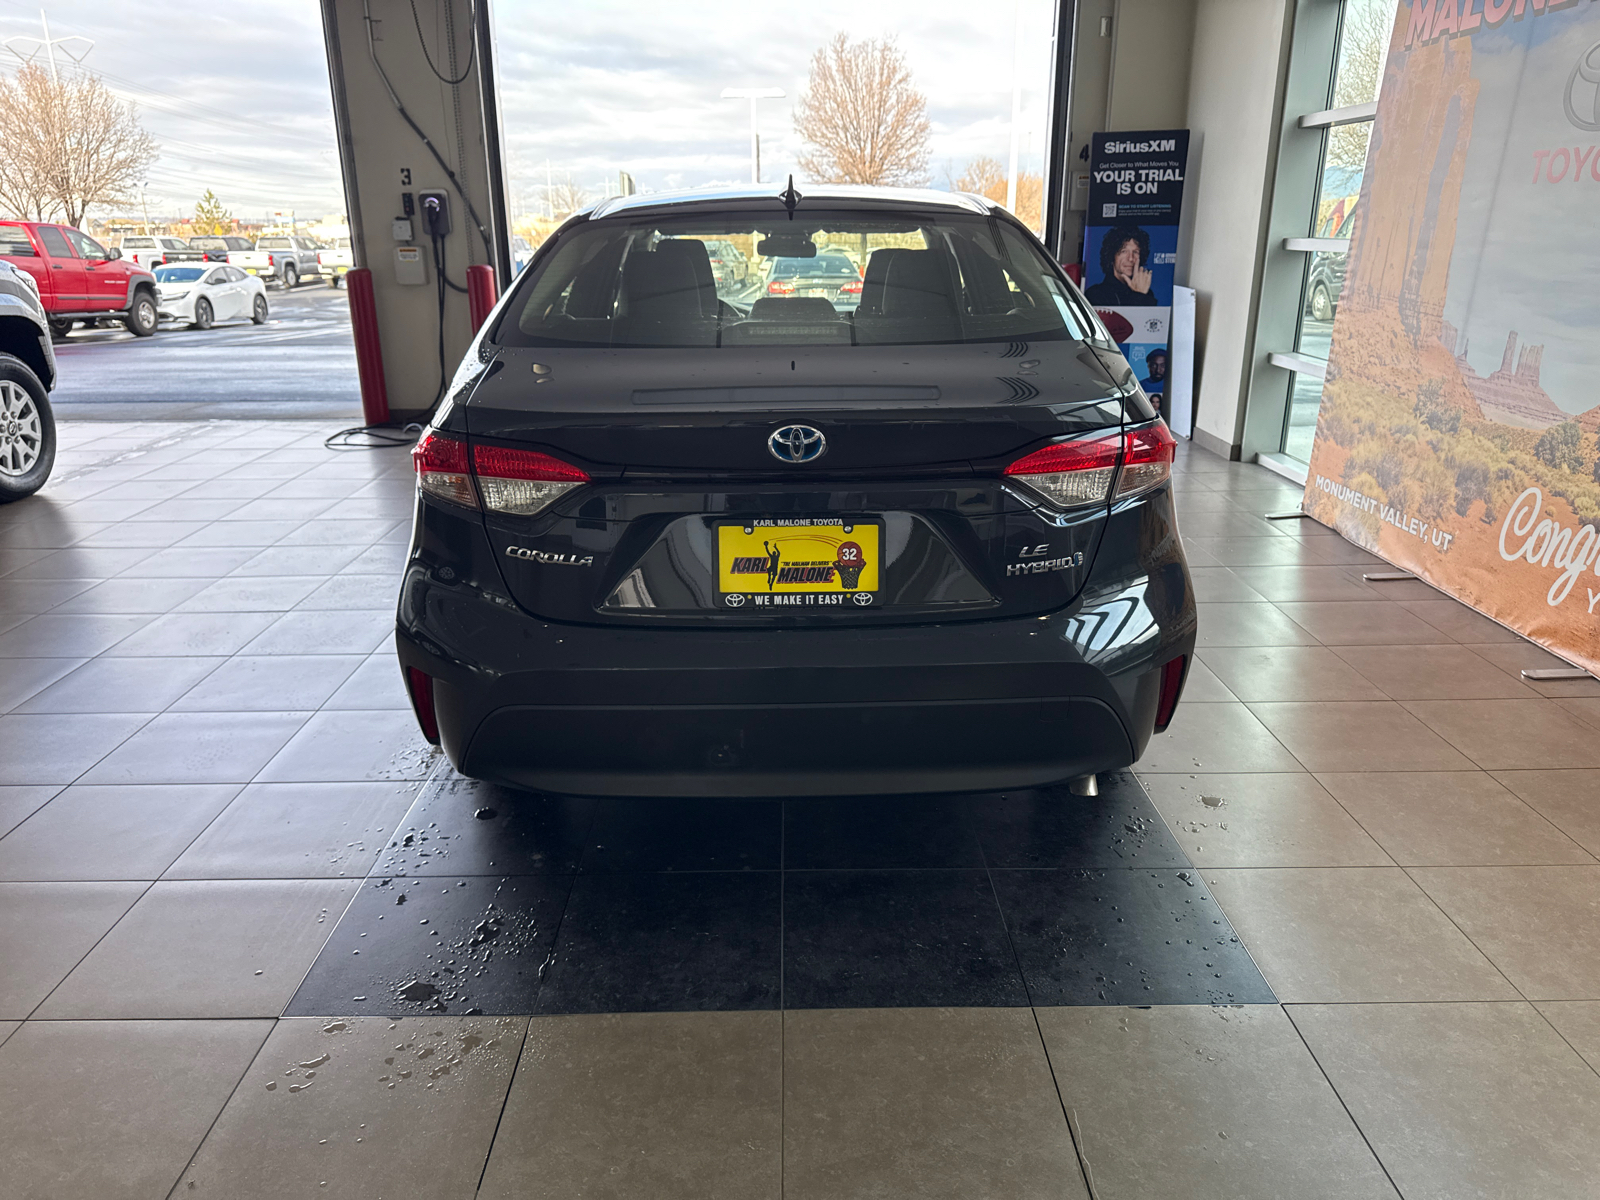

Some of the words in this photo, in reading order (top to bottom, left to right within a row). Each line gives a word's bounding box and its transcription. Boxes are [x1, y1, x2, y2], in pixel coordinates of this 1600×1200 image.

[1079, 143, 1089, 162] 4
[1104, 139, 1176, 154] SiriusXM
[401, 168, 412, 186] 3
[1093, 170, 1136, 183] YOUR
[1139, 169, 1184, 181] TRIAL
[1116, 183, 1131, 195] IS
[1134, 182, 1158, 194] ON
[1315, 474, 1378, 514] MONUMENT
[1379, 503, 1428, 543] VALLEY,
[1431, 527, 1453, 551] UT
[753, 519, 775, 527] KARL
[777, 518, 811, 527] MALONE
[813, 518, 844, 526] TOYOTA
[505, 545, 594, 567] COROLLA
[842, 548, 858, 561] 32
[1018, 543, 1050, 558] LE
[730, 556, 770, 575] KARL
[1006, 556, 1073, 577] HYBRID
[776, 566, 835, 584] MALONE
[755, 595, 770, 605] WE
[774, 595, 802, 605] MAKE
[806, 595, 816, 605] IT
[820, 594, 844, 604] EASY
